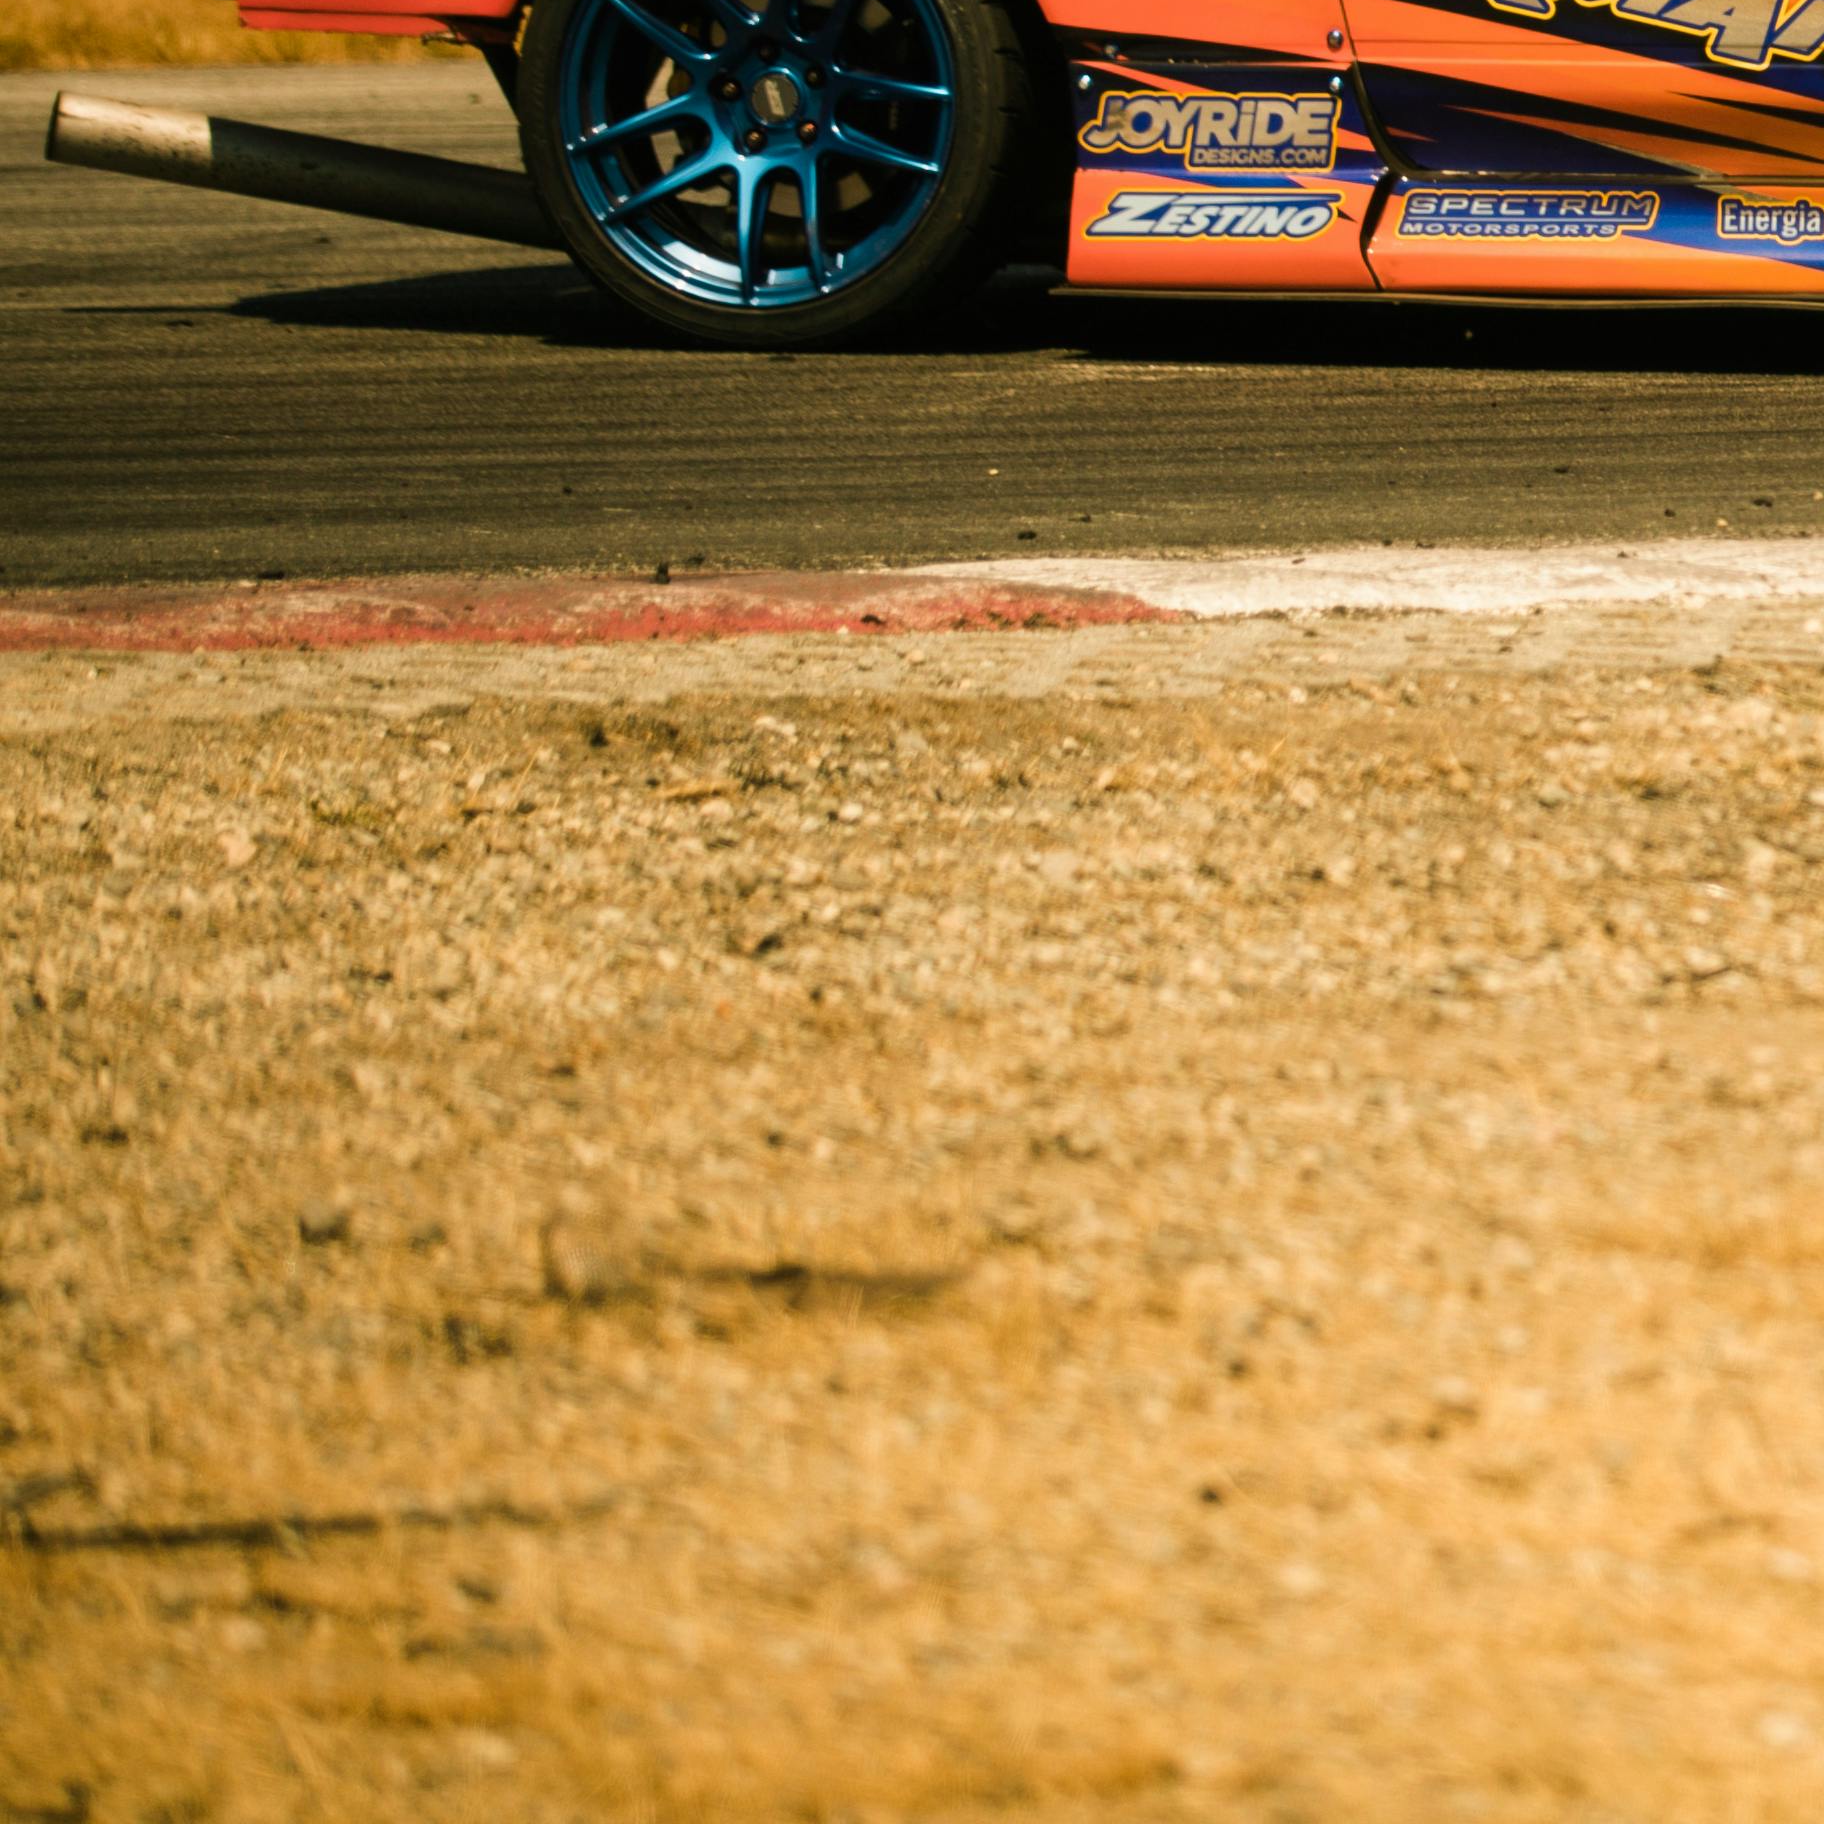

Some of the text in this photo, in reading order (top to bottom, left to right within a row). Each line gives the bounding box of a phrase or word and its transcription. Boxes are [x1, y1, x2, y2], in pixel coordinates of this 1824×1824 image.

[1192, 146, 1328, 166] DESIGNS.COM
[1085, 192, 1342, 237] ZESTINO
[1408, 194, 1655, 218] SPECTRUM
[1401, 220, 1618, 237] MOTORSPORTS
[1720, 201, 1821, 239] Energia
